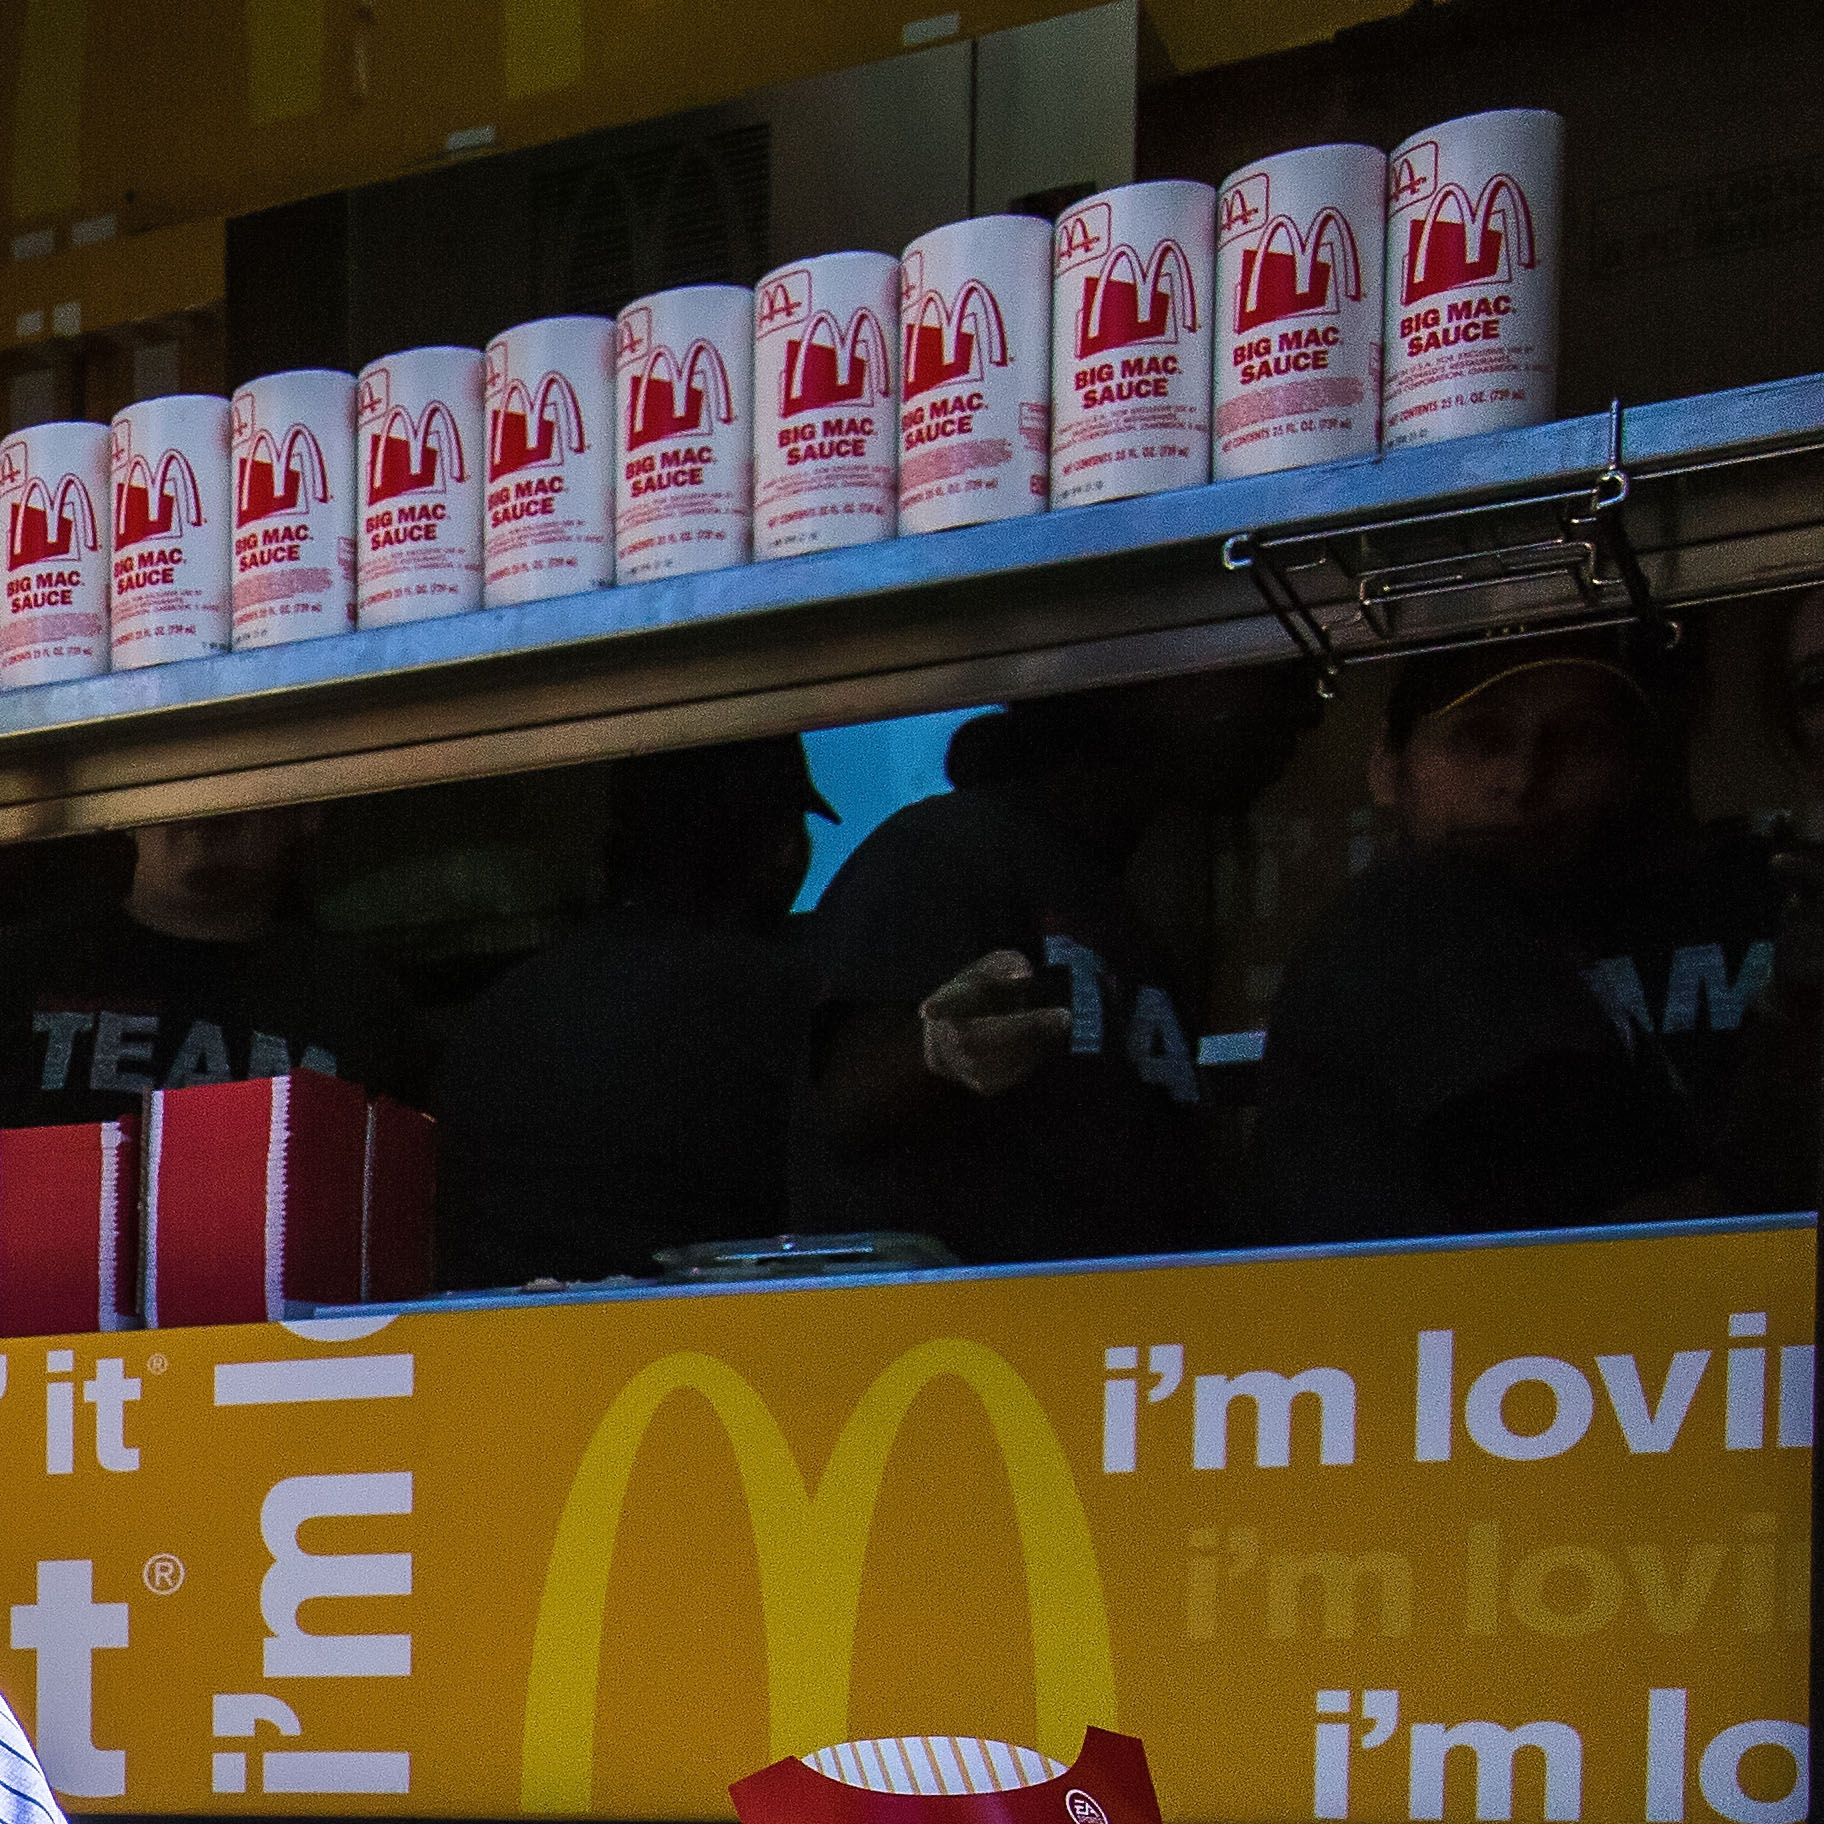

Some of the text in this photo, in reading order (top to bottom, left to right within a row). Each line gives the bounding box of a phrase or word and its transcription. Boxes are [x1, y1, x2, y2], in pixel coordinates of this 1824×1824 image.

[1400, 308, 1440, 339] BIG
[1233, 338, 1271, 366] BIG
[1407, 319, 1500, 357] SAUCE
[1074, 365, 1114, 391] BIG
[1239, 351, 1329, 385] SAUCE
[1082, 378, 1168, 409] SAUCE
[902, 406, 926, 431] BIG
[904, 414, 973, 451] SAUCE
[778, 424, 815, 448] BIG
[786, 441, 866, 466] SAUCE
[626, 457, 655, 480] BIG
[631, 468, 703, 498] SAUCE
[488, 487, 511, 510] BIG
[491, 497, 555, 528] SAUCE
[365, 510, 393, 533] BIG
[236, 533, 259, 556] BIG
[370, 523, 438, 551] SAUCE
[113, 555, 135, 578] BIG
[239, 544, 300, 573] SAUCE
[7, 575, 33, 597] BIG
[116, 568, 174, 595] SAUCE
[11, 589, 73, 613] SAUCE
[1104, 1344, 1356, 1474] i'm
[1186, 1527, 1412, 1641] i'm
[212, 1470, 415, 1796] i'm
[1314, 1688, 1584, 1822] i'm
